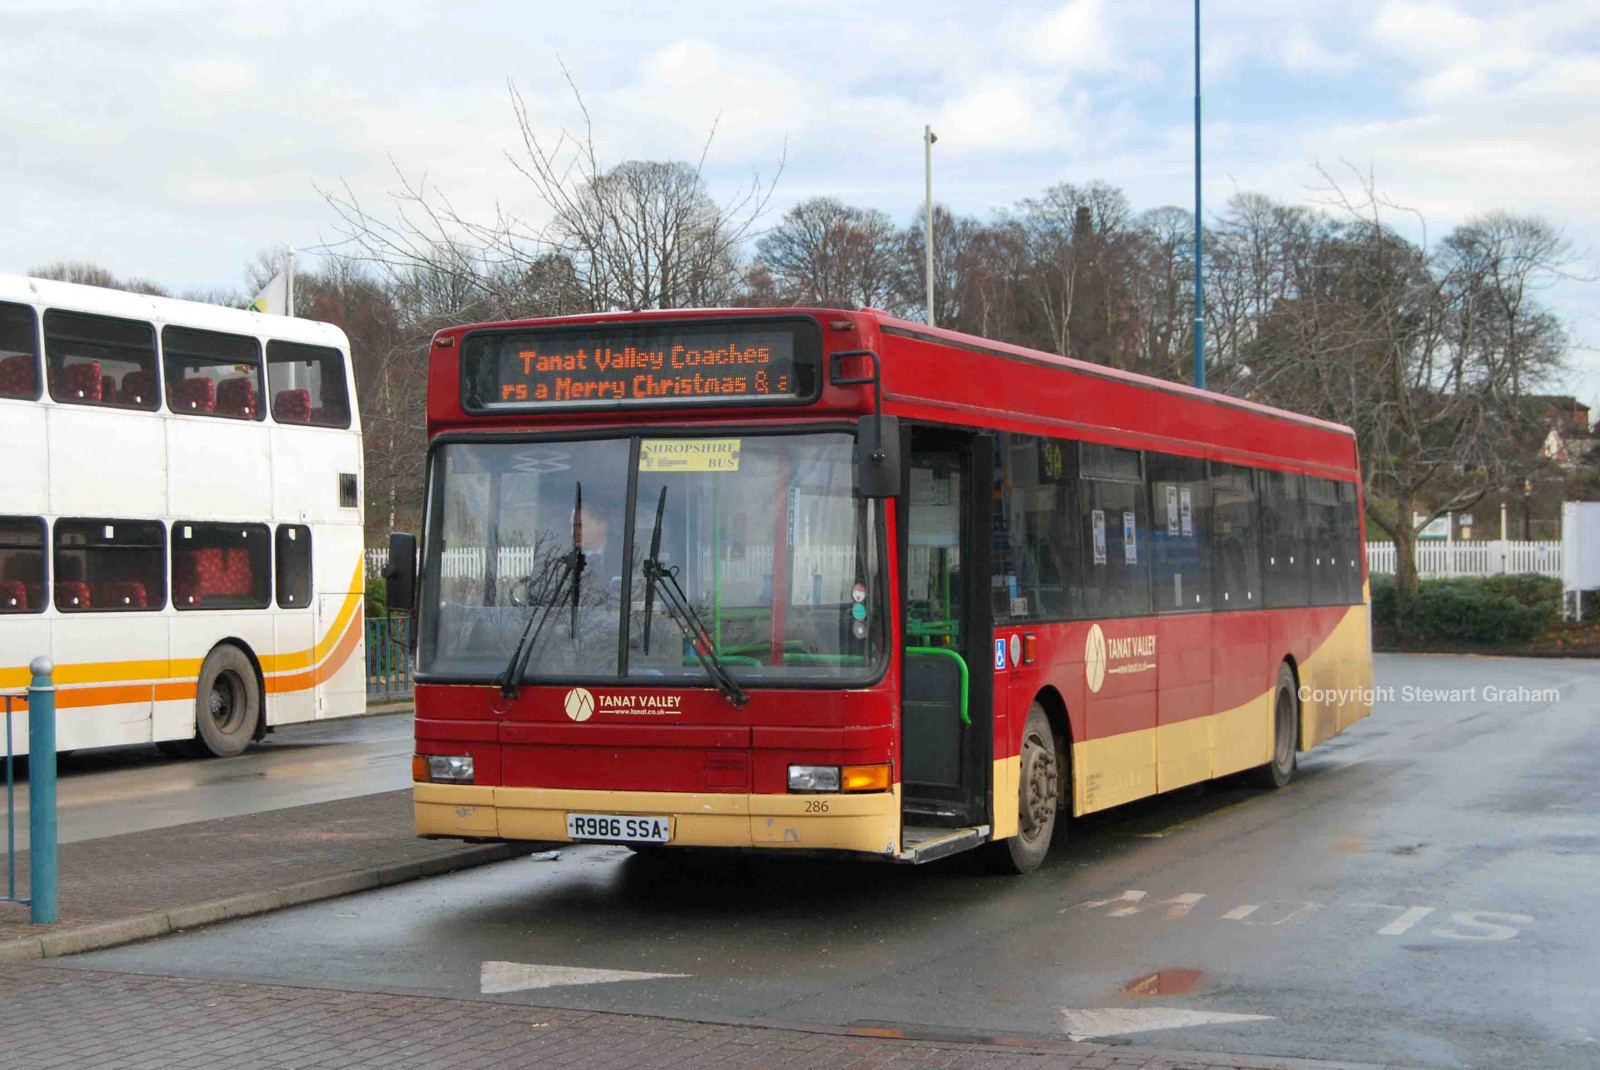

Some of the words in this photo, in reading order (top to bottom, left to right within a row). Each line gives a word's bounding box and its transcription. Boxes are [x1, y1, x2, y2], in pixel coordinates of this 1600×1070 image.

[518, 348, 587, 375] Tanat
[595, 347, 663, 371] Valley
[671, 343, 770, 369] Coaches
[501, 383, 528, 400] rs
[534, 382, 548, 399] a
[555, 376, 625, 400] Merry
[632, 372, 746, 399] Christmas
[755, 370, 769, 394] &
[645, 442, 736, 454] SHROPSHIRE
[708, 458, 735, 468] BUS
[1108, 637, 1131, 660] TANAT
[1132, 634, 1156, 657] VALLEY
[599, 696, 635, 707] TANAT
[639, 696, 682, 708] VALLEY
[614, 708, 665, 716] www.tanat.co.uk
[804, 800, 829, 813] 286
[574, 816, 621, 837] R986
[626, 819, 666, 839] SSA
